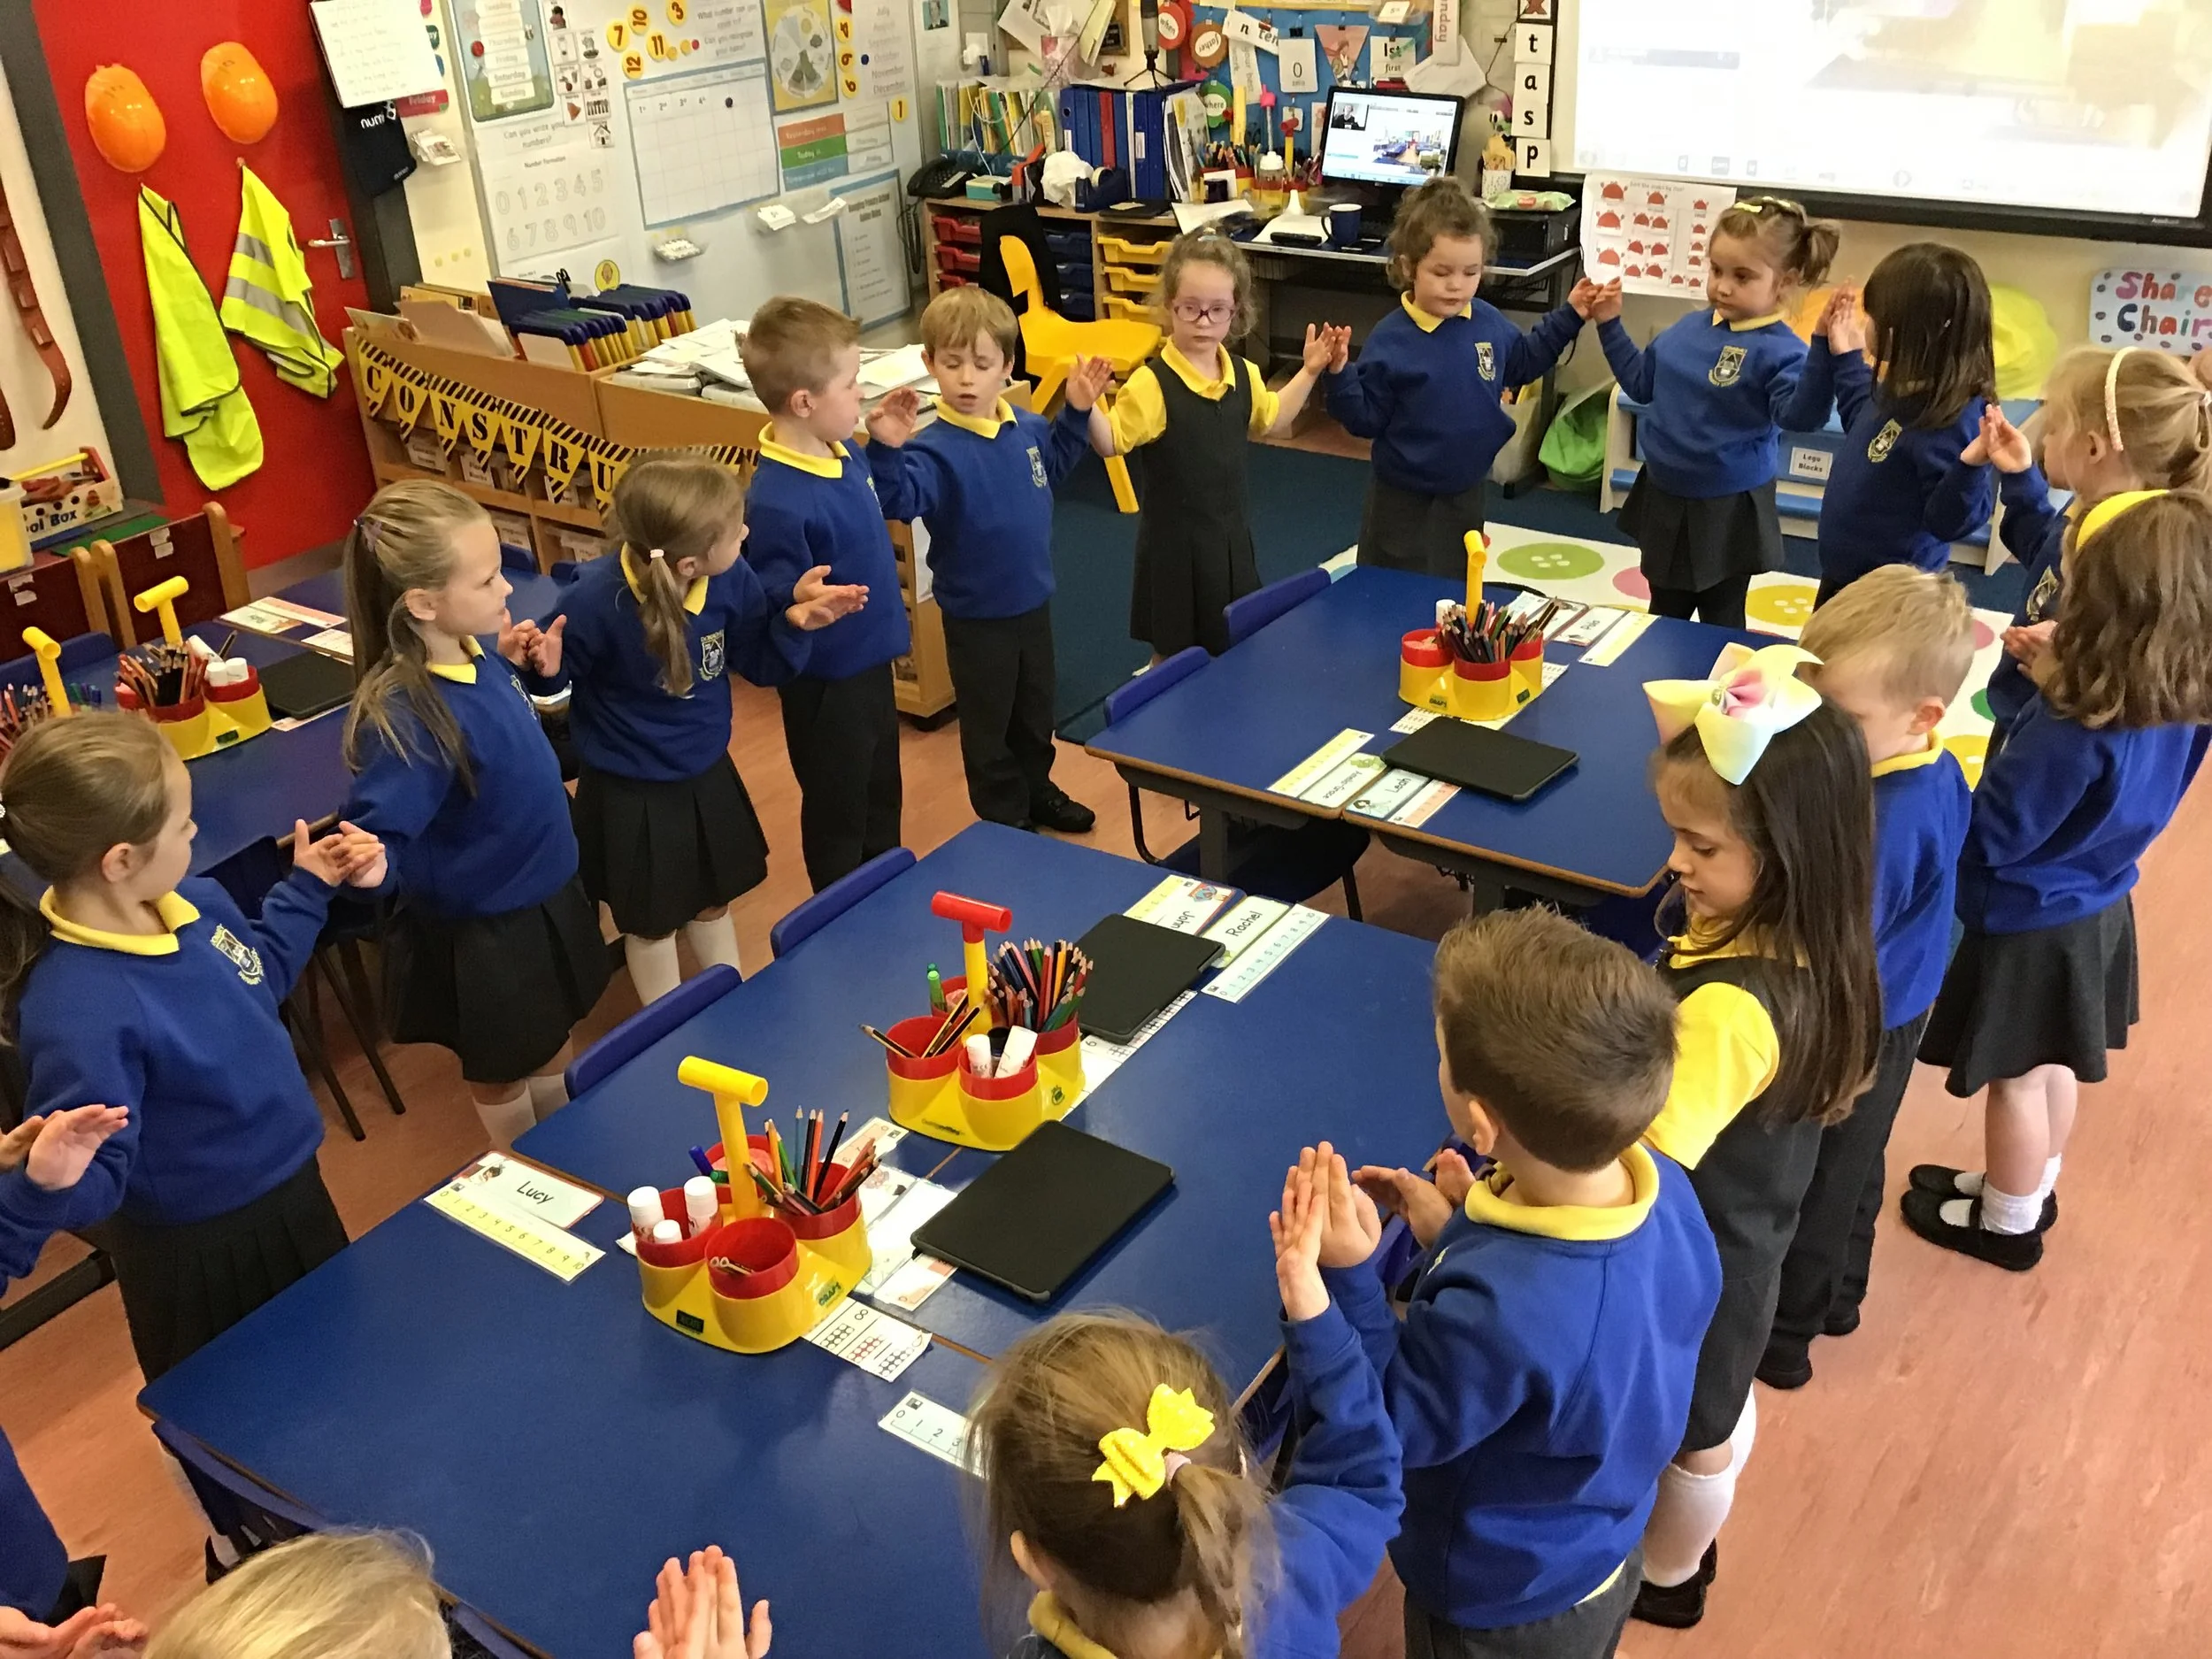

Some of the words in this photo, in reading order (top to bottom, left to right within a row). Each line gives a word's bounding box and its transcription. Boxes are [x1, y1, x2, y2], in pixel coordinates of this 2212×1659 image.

[633, 10, 647, 27] 10
[672, 2, 684, 20] 3
[876, 6, 890, 17] July
[614, 25, 623, 46] 7
[1159, 18, 1176, 35] when
[651, 35, 664, 56] 11
[1528, 34, 1538, 53] t
[626, 56, 641, 73] 12
[872, 65, 904, 79] November
[1385, 63, 1402, 74] first
[872, 80, 906, 94] December
[1524, 74, 1538, 90] a
[409, 95, 436, 106] Friday
[1524, 109, 1534, 126] s
[1526, 144, 1539, 169] p
[495, 190, 511, 215] 0
[517, 187, 527, 211] 1
[534, 182, 549, 207] 2
[554, 178, 569, 202] 3
[507, 227, 520, 250] 6
[525, 222, 538, 247] 7
[543, 219, 559, 242] 8
[563, 213, 578, 236] 9
[583, 207, 606, 233] 10
[2116, 271, 2212, 309] Share
[2117, 303, 2212, 337] Chair
[1802, 453, 1821, 464] Lego
[1798, 463, 1824, 473] Blocks
[26, 520, 44, 533] ol
[50, 509, 78, 527] Box
[1385, 778, 1412, 794] Leah
[1171, 910, 1195, 930] John
[1225, 910, 1263, 937] Rachel
[516, 1180, 556, 1206] Lucy
[818, 1280, 842, 1307] CRAFT
[854, 1309, 869, 1321] 8
[895, 1409, 906, 1418] 0
[915, 1419, 924, 1428] 1
[933, 1428, 943, 1438] 2
[951, 1437, 963, 1448] 3
